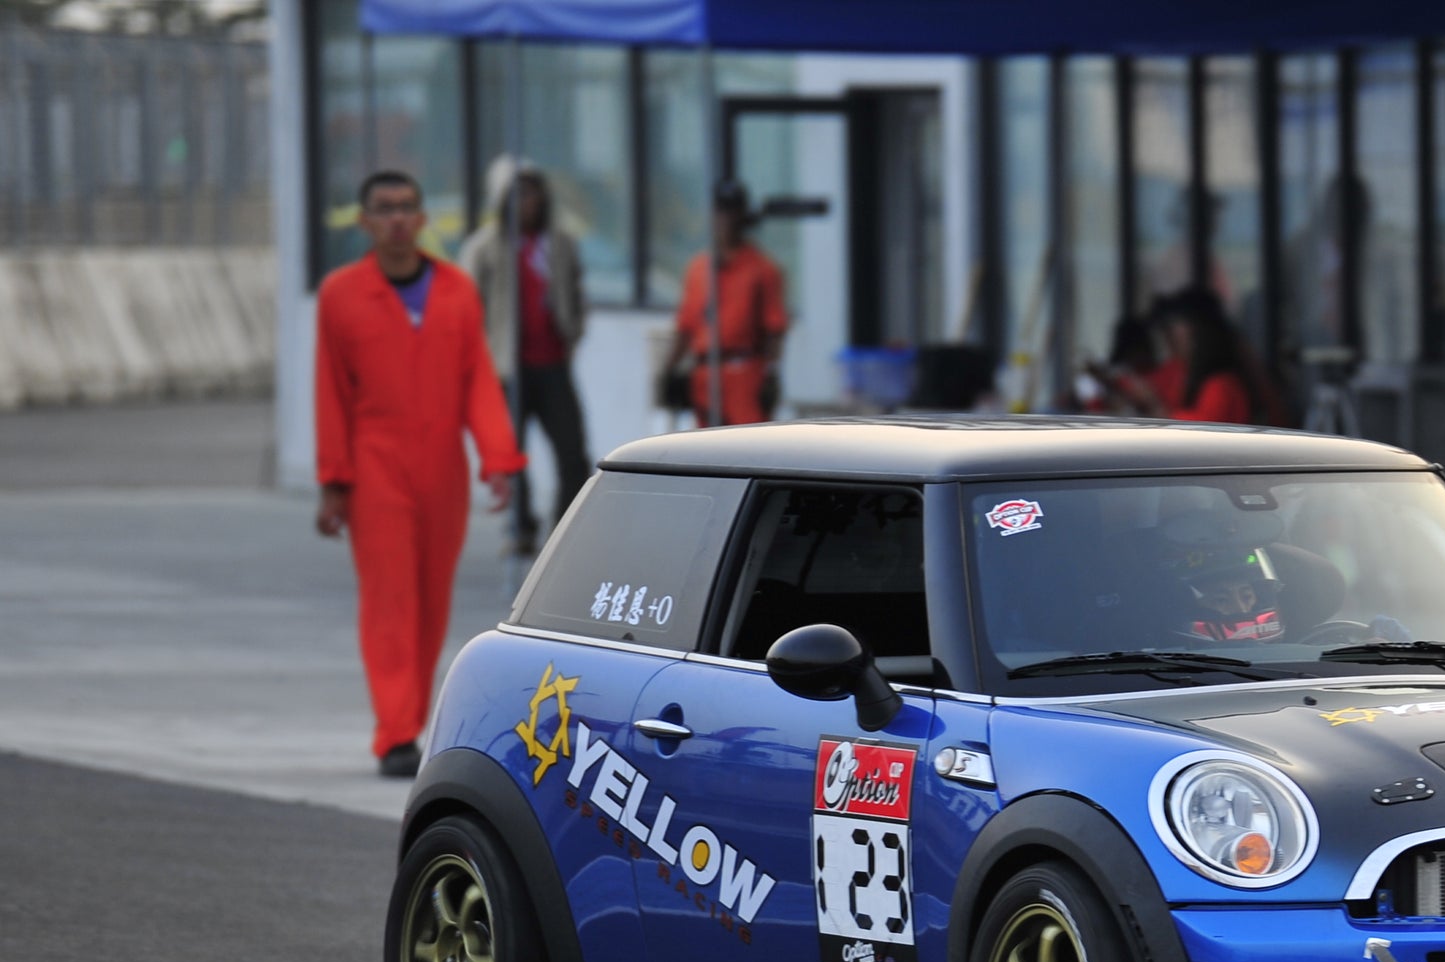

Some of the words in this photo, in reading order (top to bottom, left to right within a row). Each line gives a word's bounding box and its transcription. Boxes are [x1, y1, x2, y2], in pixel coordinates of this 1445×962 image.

[823, 741, 900, 814] Option
[565, 789, 642, 860] SPEED
[567, 721, 776, 924] YELLOW
[658, 861, 753, 945] RACING
[817, 828, 909, 934] 123
